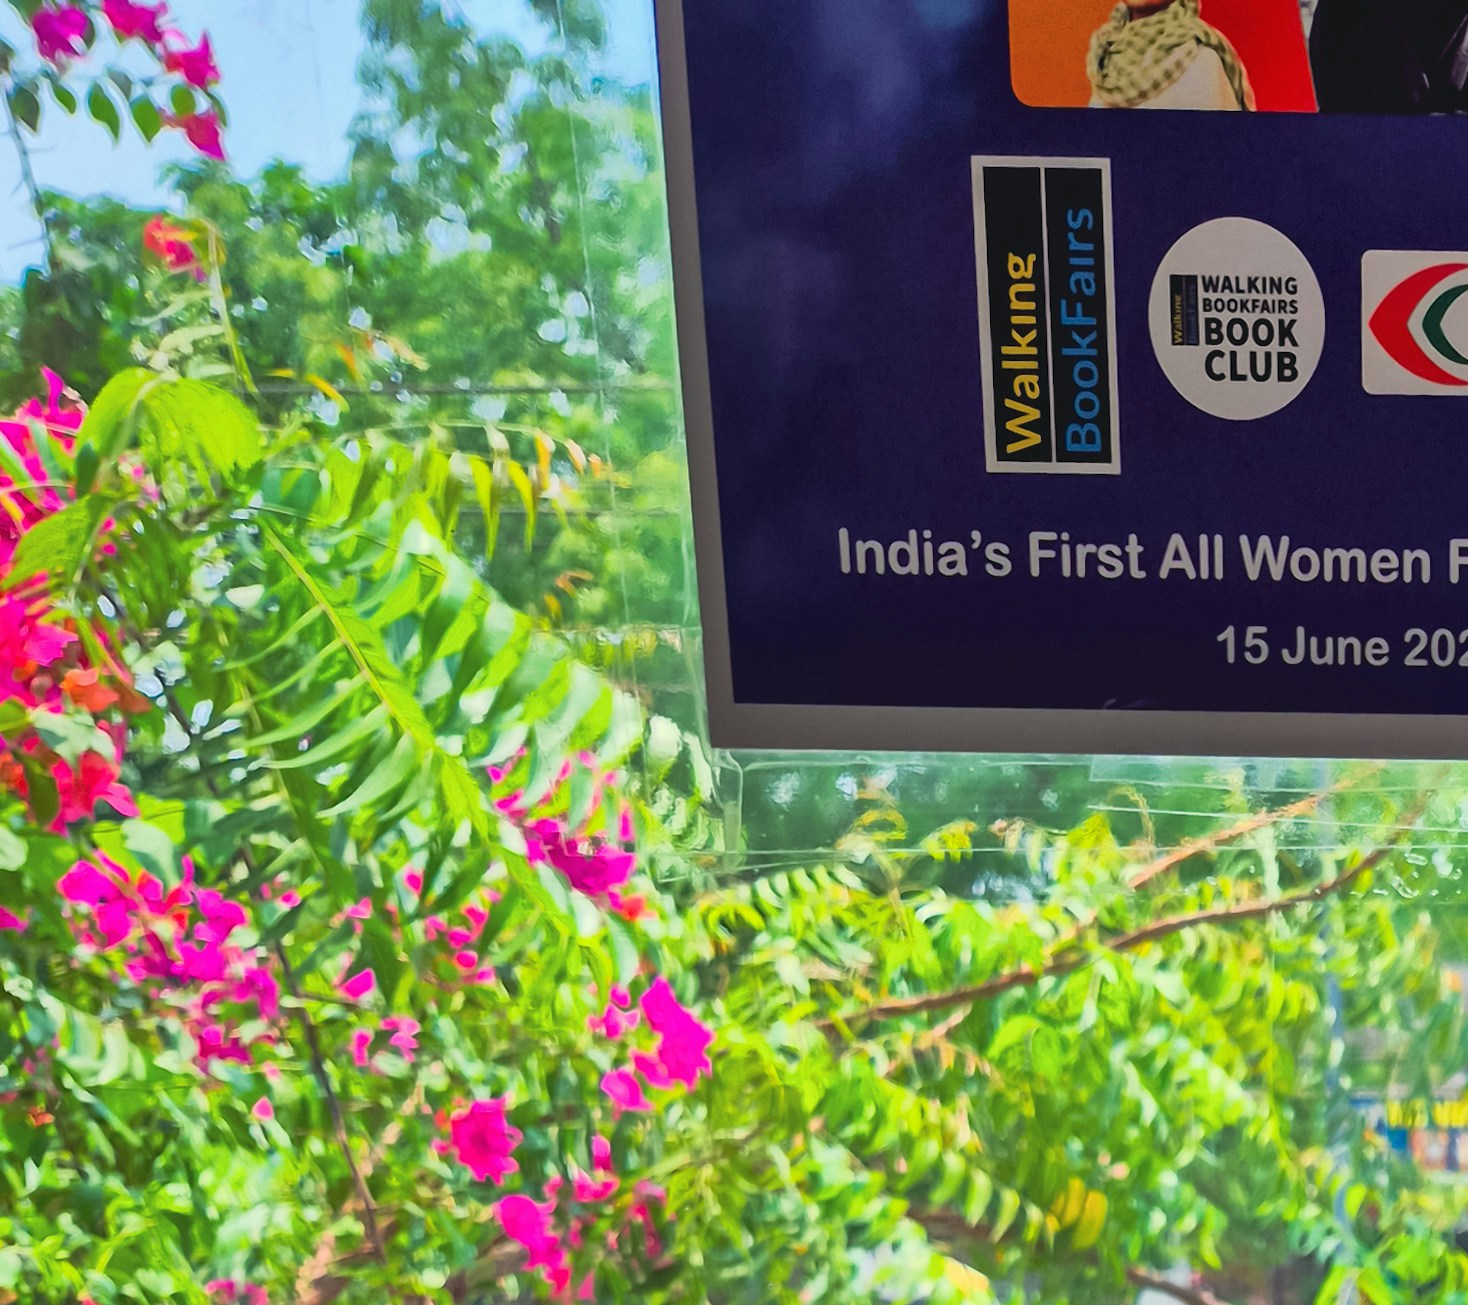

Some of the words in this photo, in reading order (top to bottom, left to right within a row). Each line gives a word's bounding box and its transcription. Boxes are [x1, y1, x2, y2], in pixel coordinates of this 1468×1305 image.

[1202, 275, 1298, 295] WALKING
[1203, 298, 1298, 314] BOOKFAIRS
[1060, 207, 1102, 453] BookFairs
[1204, 317, 1299, 347] BOOK
[1001, 252, 1042, 454] Walking
[1205, 350, 1299, 382] CLUB
[839, 528, 1011, 576] India’s
[1029, 532, 1146, 578] First
[1160, 533, 1223, 580] All
[1239, 534, 1430, 583] Women
[1217, 626, 1268, 664] 15
[1282, 626, 1389, 666] June
